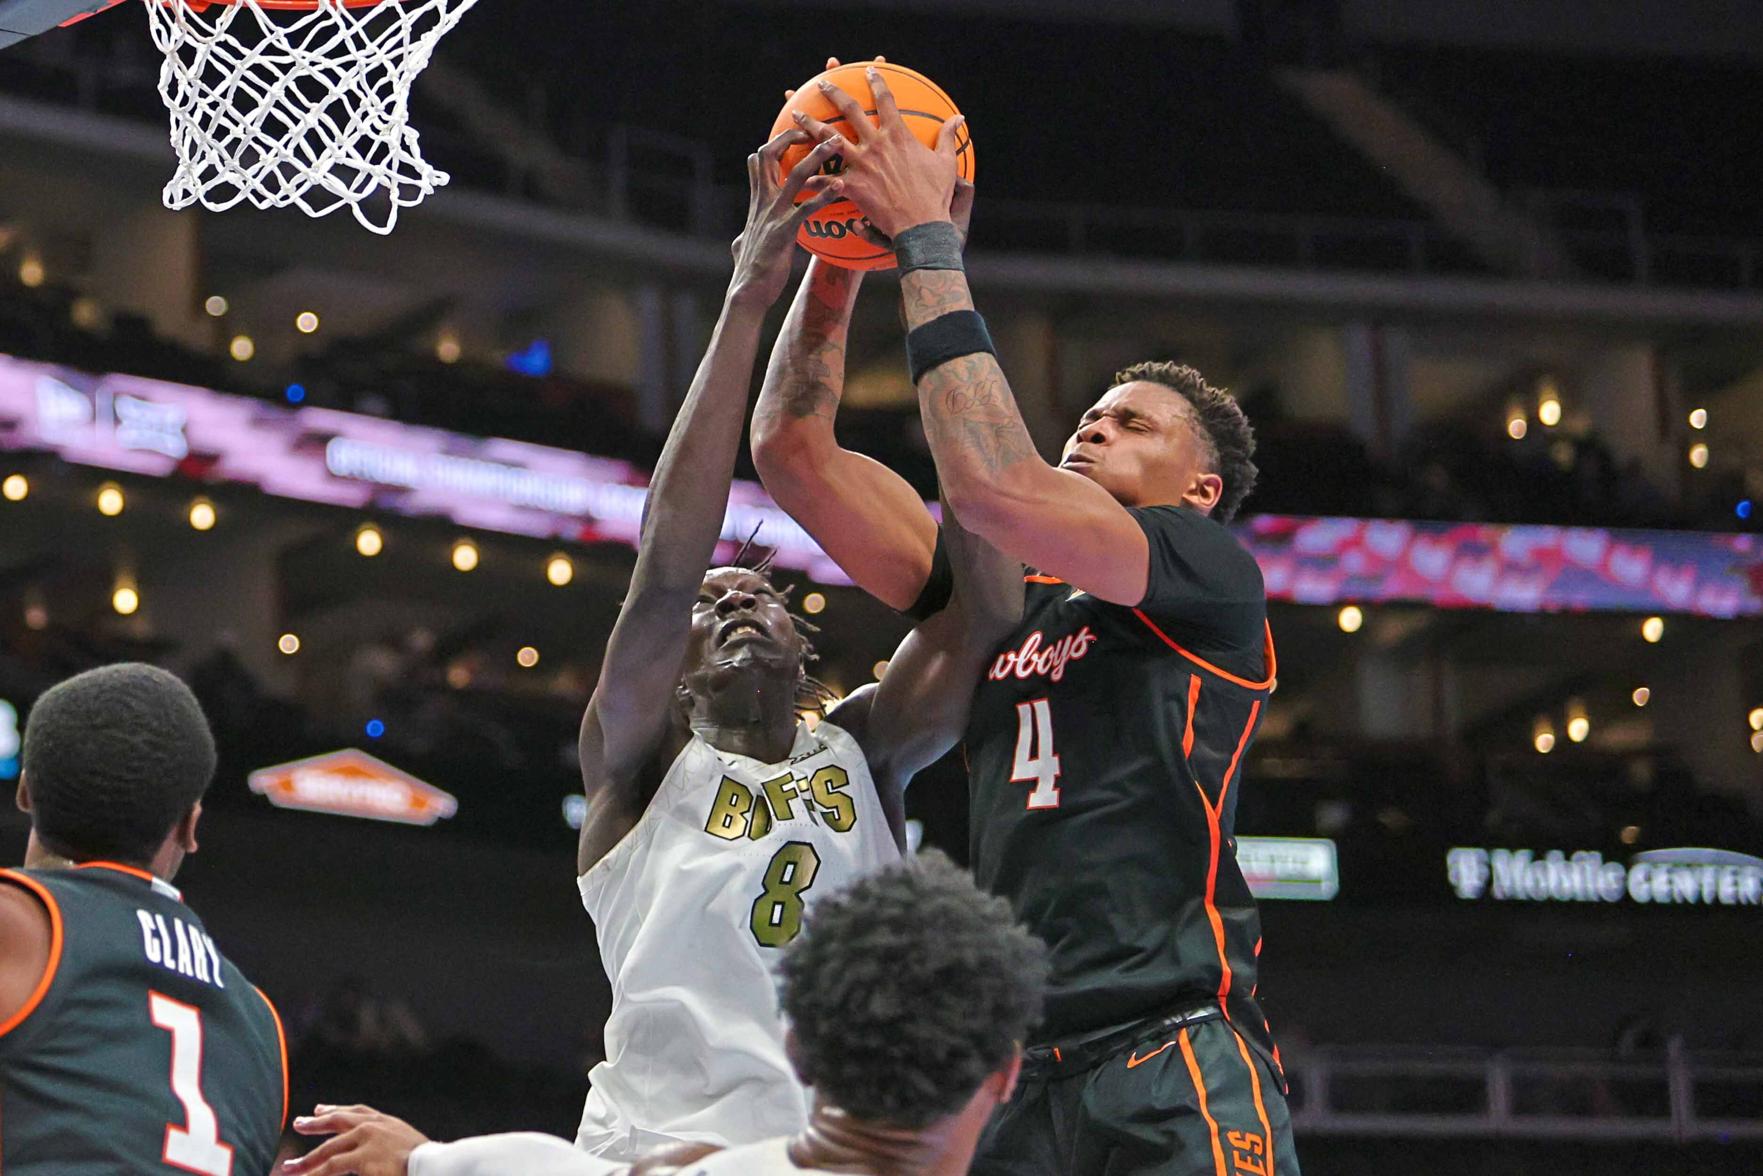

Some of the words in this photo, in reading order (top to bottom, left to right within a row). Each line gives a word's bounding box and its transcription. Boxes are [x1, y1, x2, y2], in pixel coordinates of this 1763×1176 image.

[988, 626, 1097, 683] wboys
[1009, 698, 1061, 810] 4
[749, 840, 822, 948] 8
[136, 908, 225, 989] CLARY
[148, 988, 235, 1176] 1
